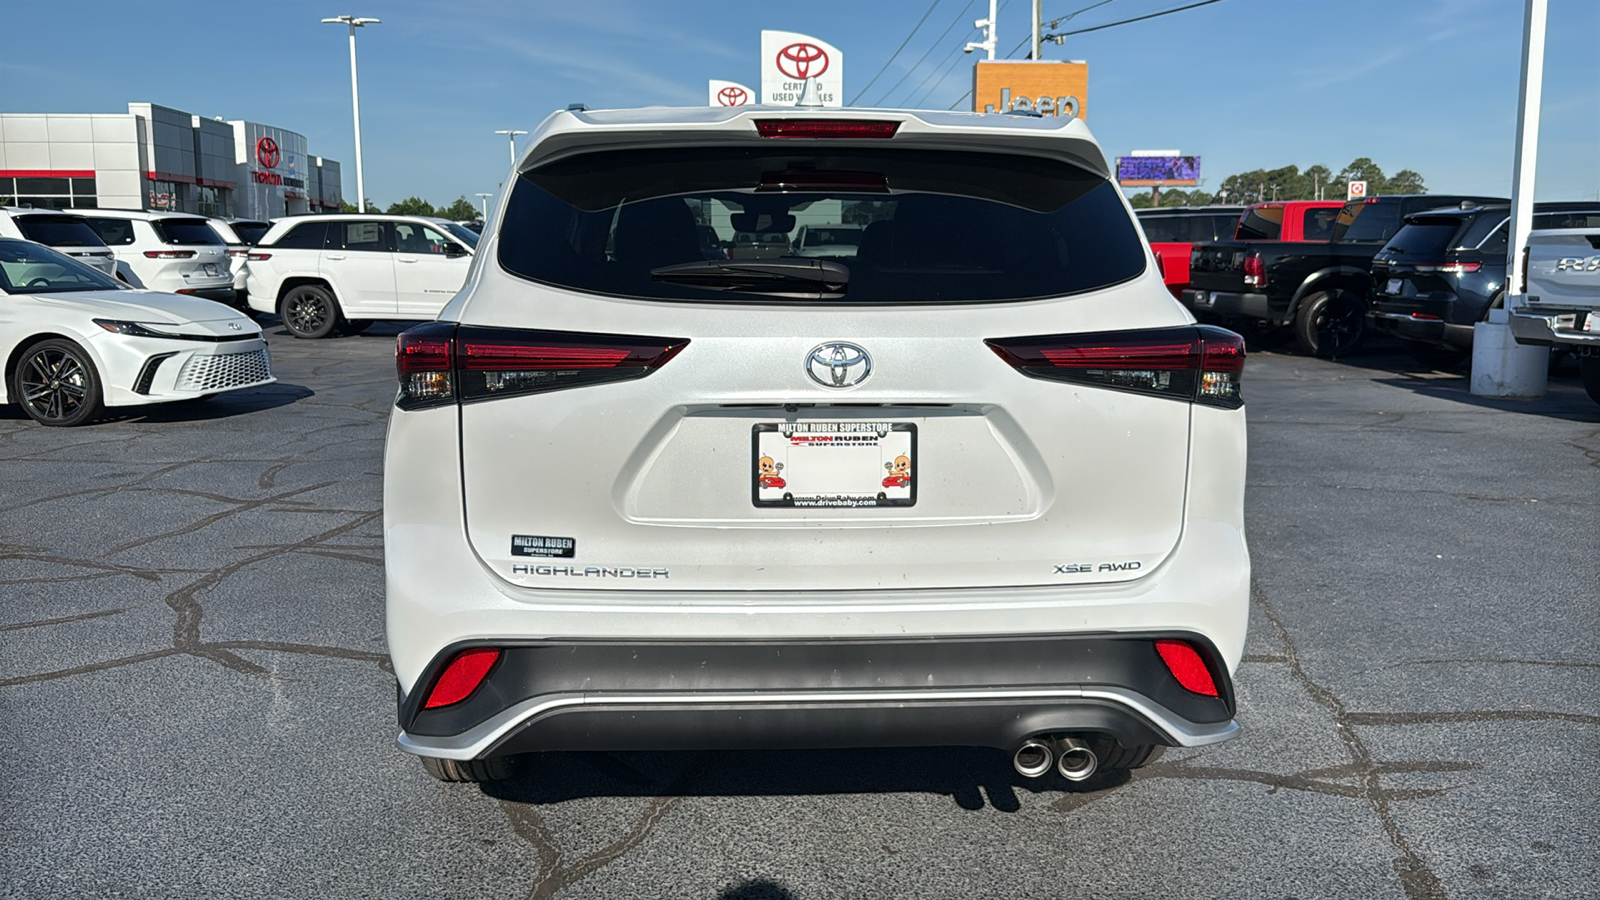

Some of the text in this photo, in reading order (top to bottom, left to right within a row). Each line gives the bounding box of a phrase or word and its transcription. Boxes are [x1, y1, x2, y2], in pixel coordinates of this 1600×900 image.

[783, 82, 823, 91] CERTD
[772, 93, 834, 102] USED VLES
[985, 88, 1080, 118] Jeep
[252, 171, 283, 186] TOYOTA
[1557, 256, 1600, 271] RA
[777, 423, 893, 432] MILTON RUBEN SUPERSTORE
[794, 500, 877, 508] www.drivebaby.com
[513, 536, 573, 549] MILTON RUBEN
[512, 564, 670, 579] HIGHLANDER
[1053, 561, 1141, 574] XSE AWD
